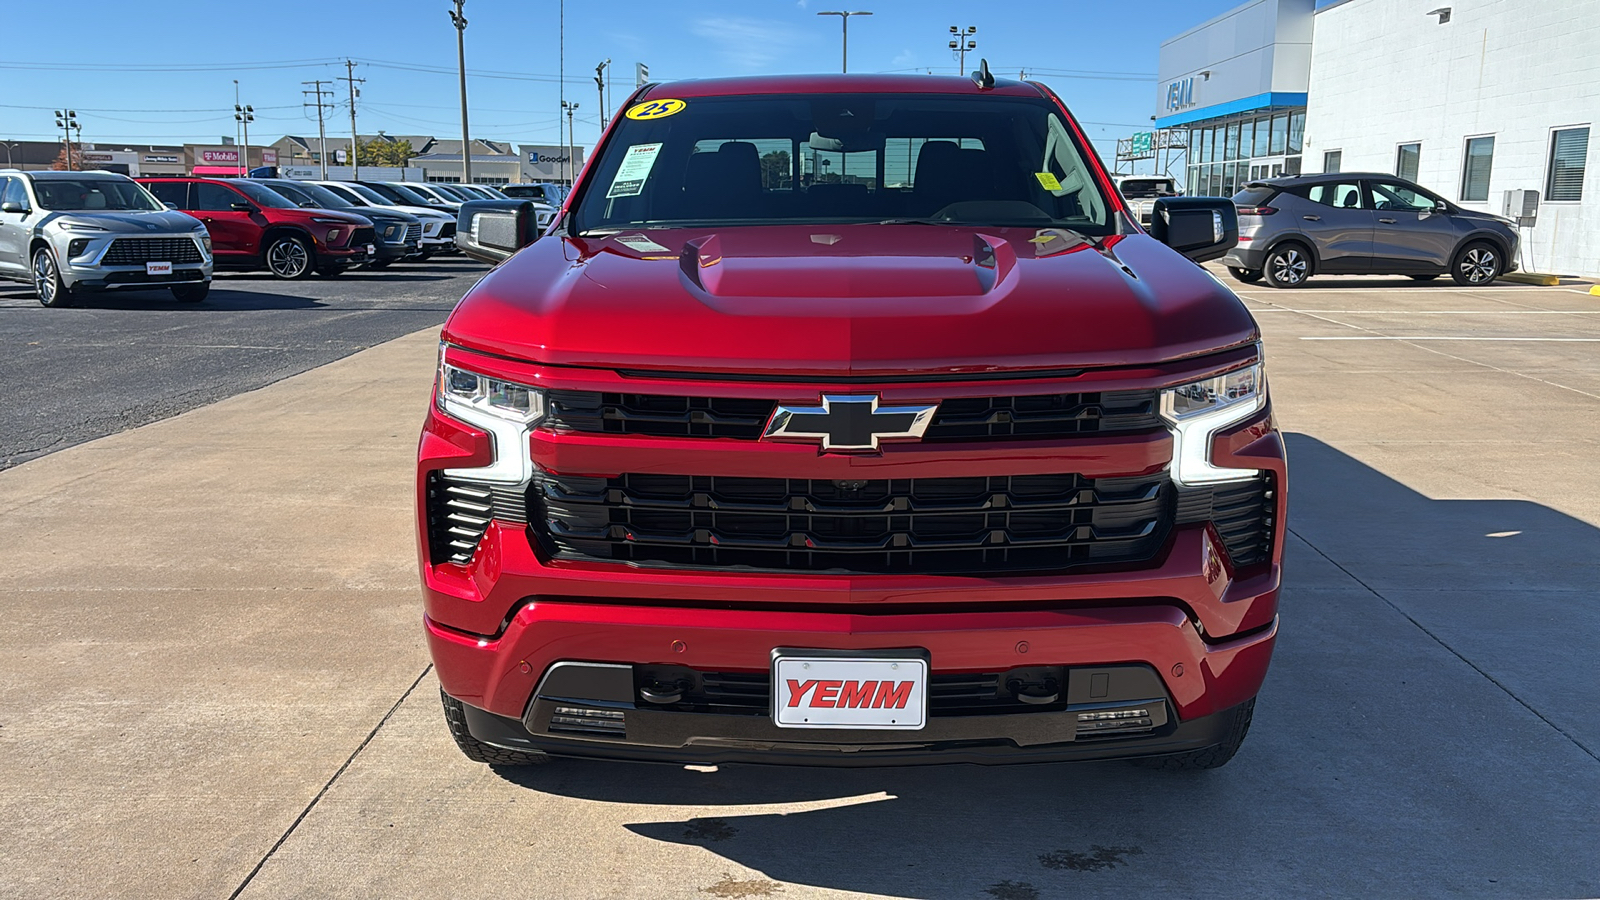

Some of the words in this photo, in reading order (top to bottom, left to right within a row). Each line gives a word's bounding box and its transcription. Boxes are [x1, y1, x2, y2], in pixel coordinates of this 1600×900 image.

[1166, 77, 1194, 109] YEMM
[638, 101, 676, 117] 25
[212, 152, 237, 160] Mobile
[786, 679, 915, 709] YEMM
